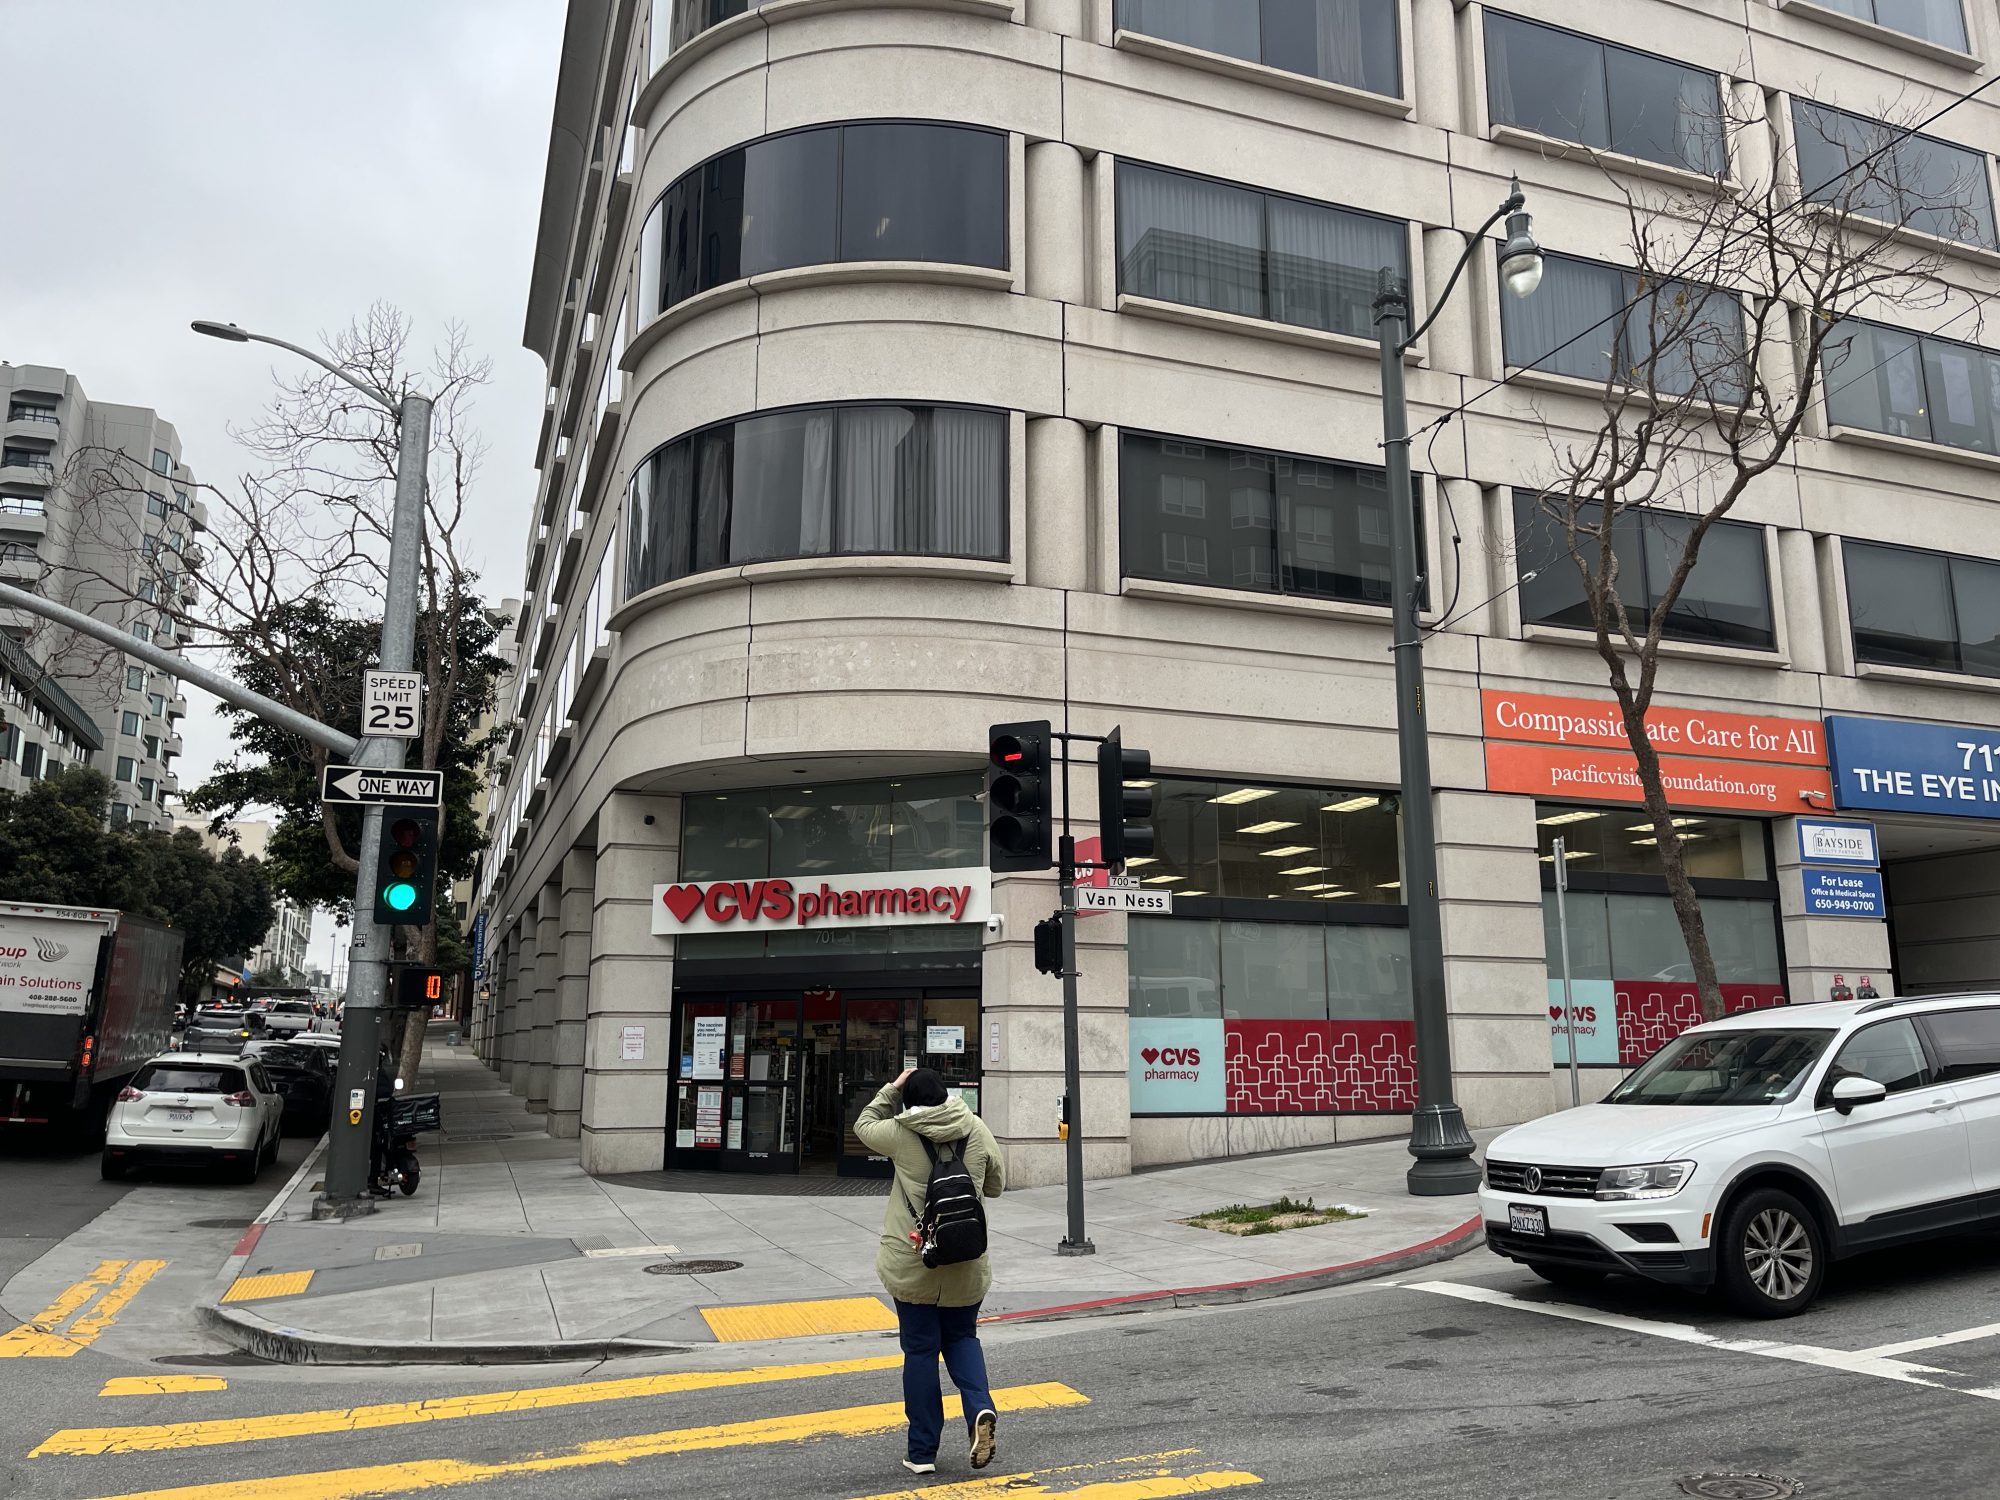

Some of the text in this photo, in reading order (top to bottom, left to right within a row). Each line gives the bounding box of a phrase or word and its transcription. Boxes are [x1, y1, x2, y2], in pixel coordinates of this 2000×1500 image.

[370, 678, 417, 690] SPEED
[373, 691, 412, 703] LIMIT
[368, 704, 415, 729] 25
[1496, 701, 1817, 755] Compassioate Care for All
[357, 778, 431, 796] ONE WAY
[1551, 763, 1777, 802] pacificvisiooundation.org
[1852, 767, 1914, 796] THE
[1921, 773, 1977, 801] EYE
[1816, 837, 1863, 850] BAYSIDE
[1111, 877, 1129, 886] 700
[1821, 875, 1864, 888] For Lease
[1085, 892, 1164, 908] Van Ness
[1811, 888, 1876, 899] Office & Medical Space
[704, 879, 972, 926] CVS pharmacy
[1815, 898, 1875, 911] 650-949-0700
[815, 927, 835, 944] 701
[19, 975, 82, 990] Solutions
[1551, 1024, 1597, 1037] phamacy
[1160, 1047, 1201, 1066] CVS
[1144, 1068, 1200, 1083] pharmacy
